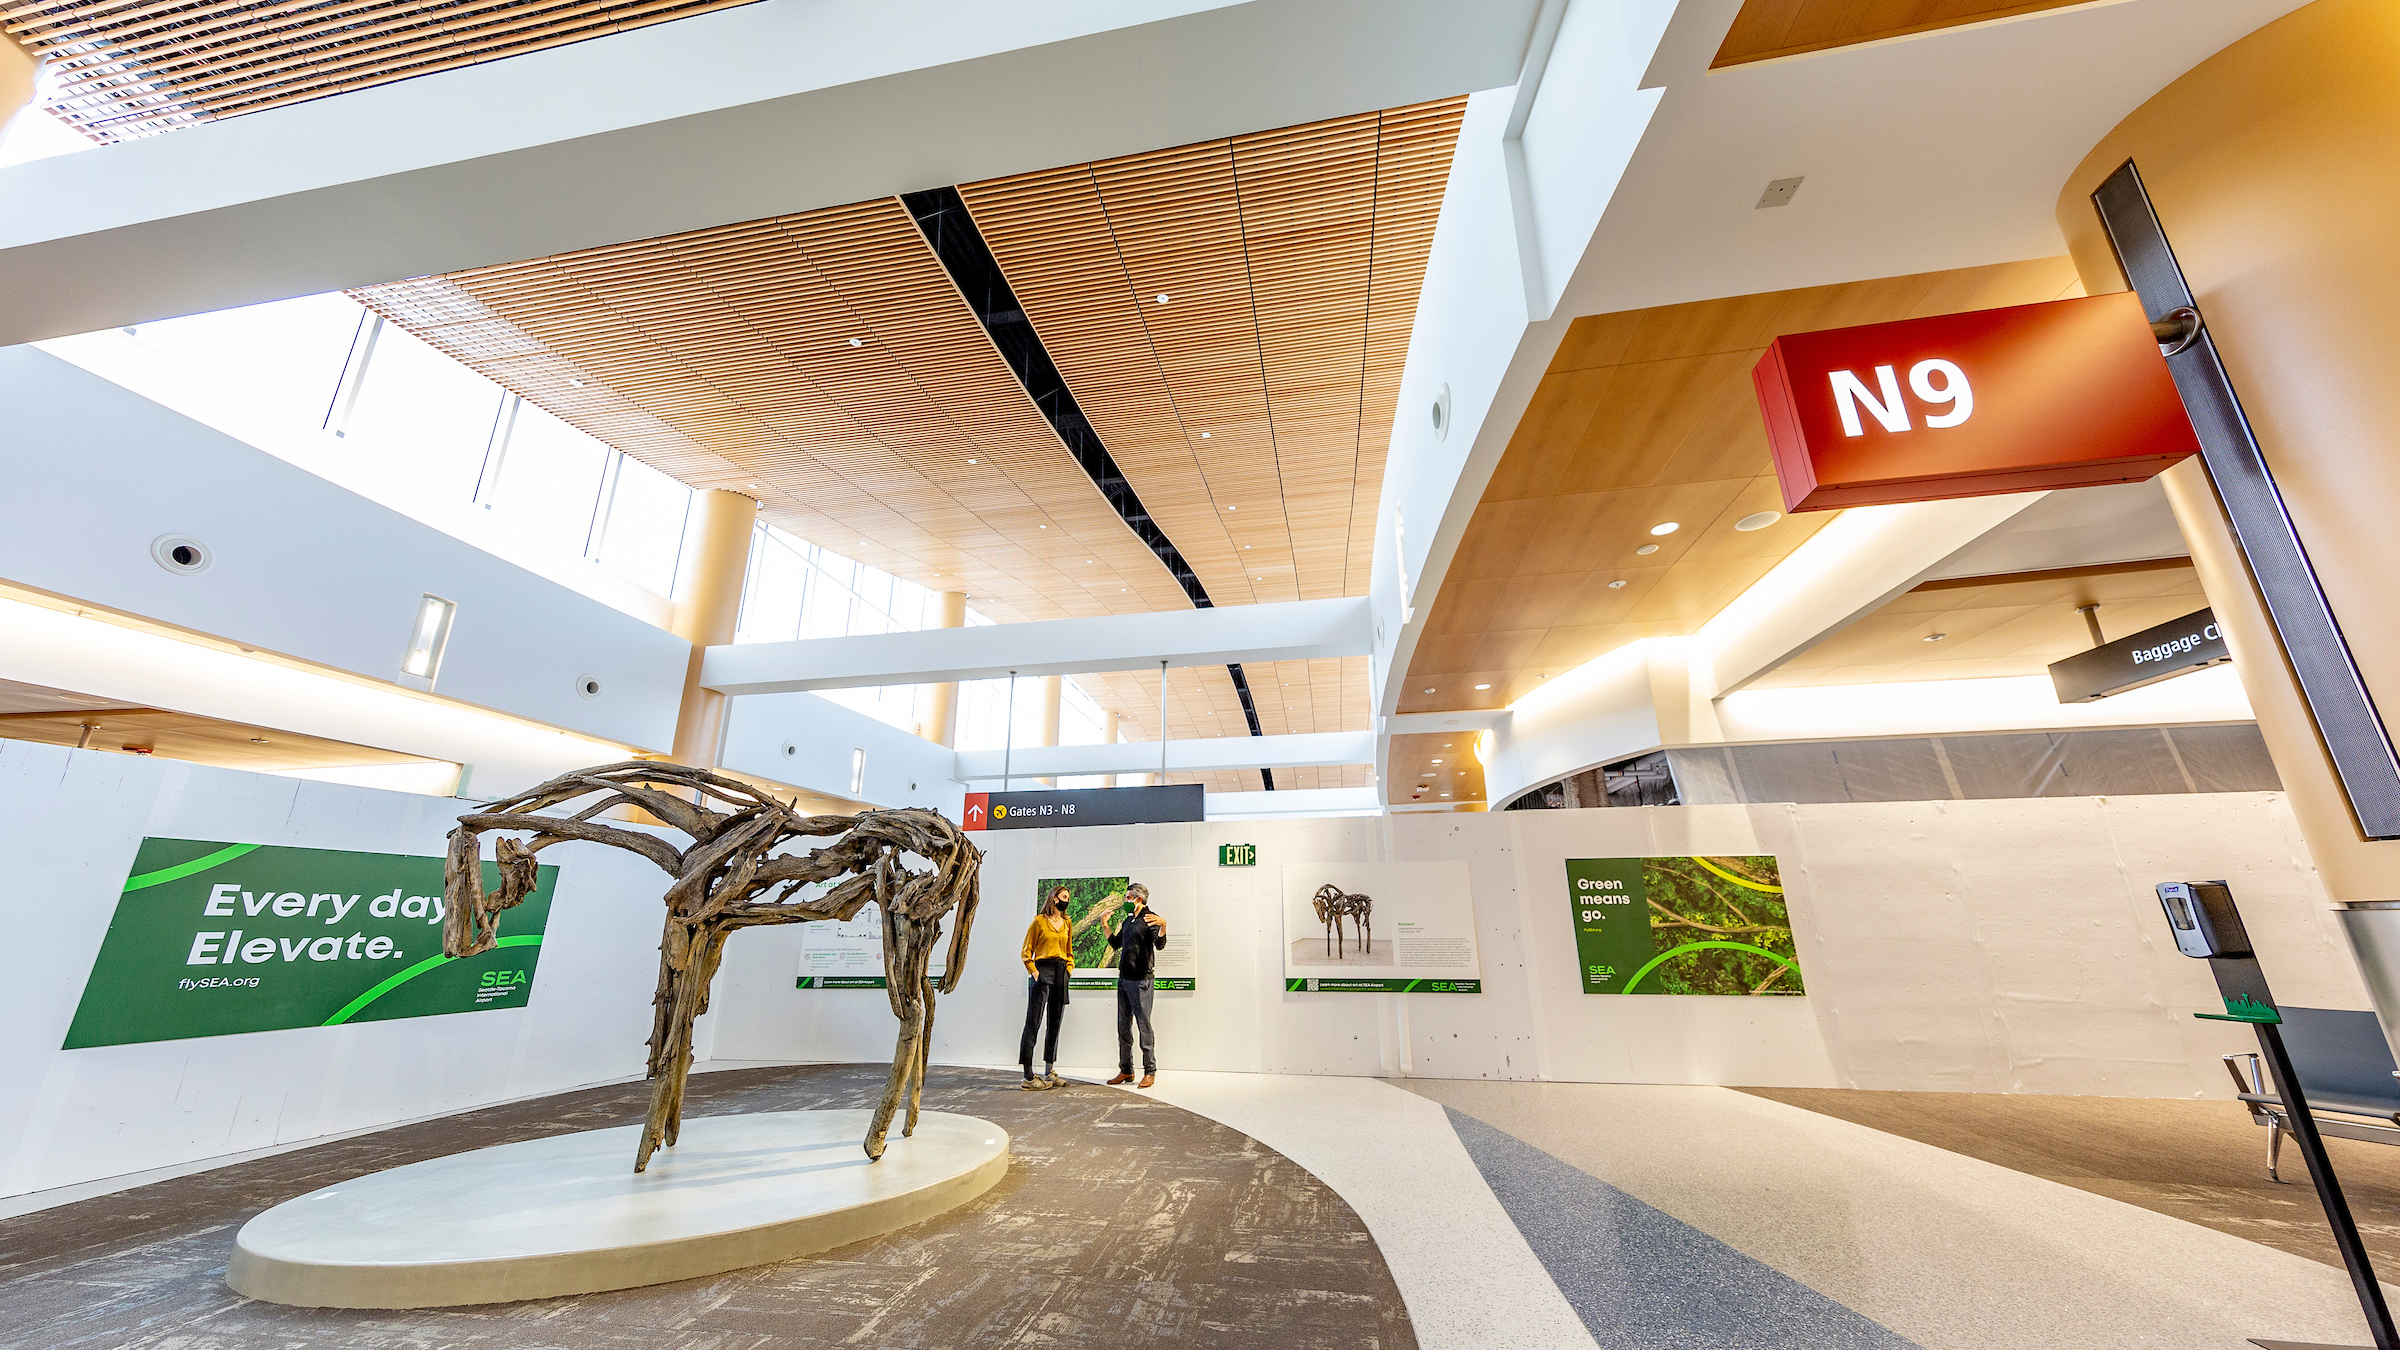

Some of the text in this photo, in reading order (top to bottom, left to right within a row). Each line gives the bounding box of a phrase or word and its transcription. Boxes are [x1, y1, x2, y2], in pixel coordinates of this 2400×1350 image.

[1827, 358, 1974, 437] N9
[2131, 632, 2201, 665] Baggage
[1009, 806, 1037, 817] Gates
[1039, 804, 1053, 816] N3
[1061, 803, 1076, 815] N8
[1226, 846, 1250, 865] EXIT
[1577, 878, 1623, 890] Green
[203, 883, 446, 925] Every day
[1579, 894, 1631, 905] means
[1581, 909, 1606, 923] go.
[185, 929, 404, 965] Elevate.
[1589, 965, 1616, 975] SEA
[178, 977, 260, 991] flySEA.org
[480, 969, 527, 986] SEA
[1153, 980, 1175, 990] SEA
[1431, 982, 1458, 992] SEA
